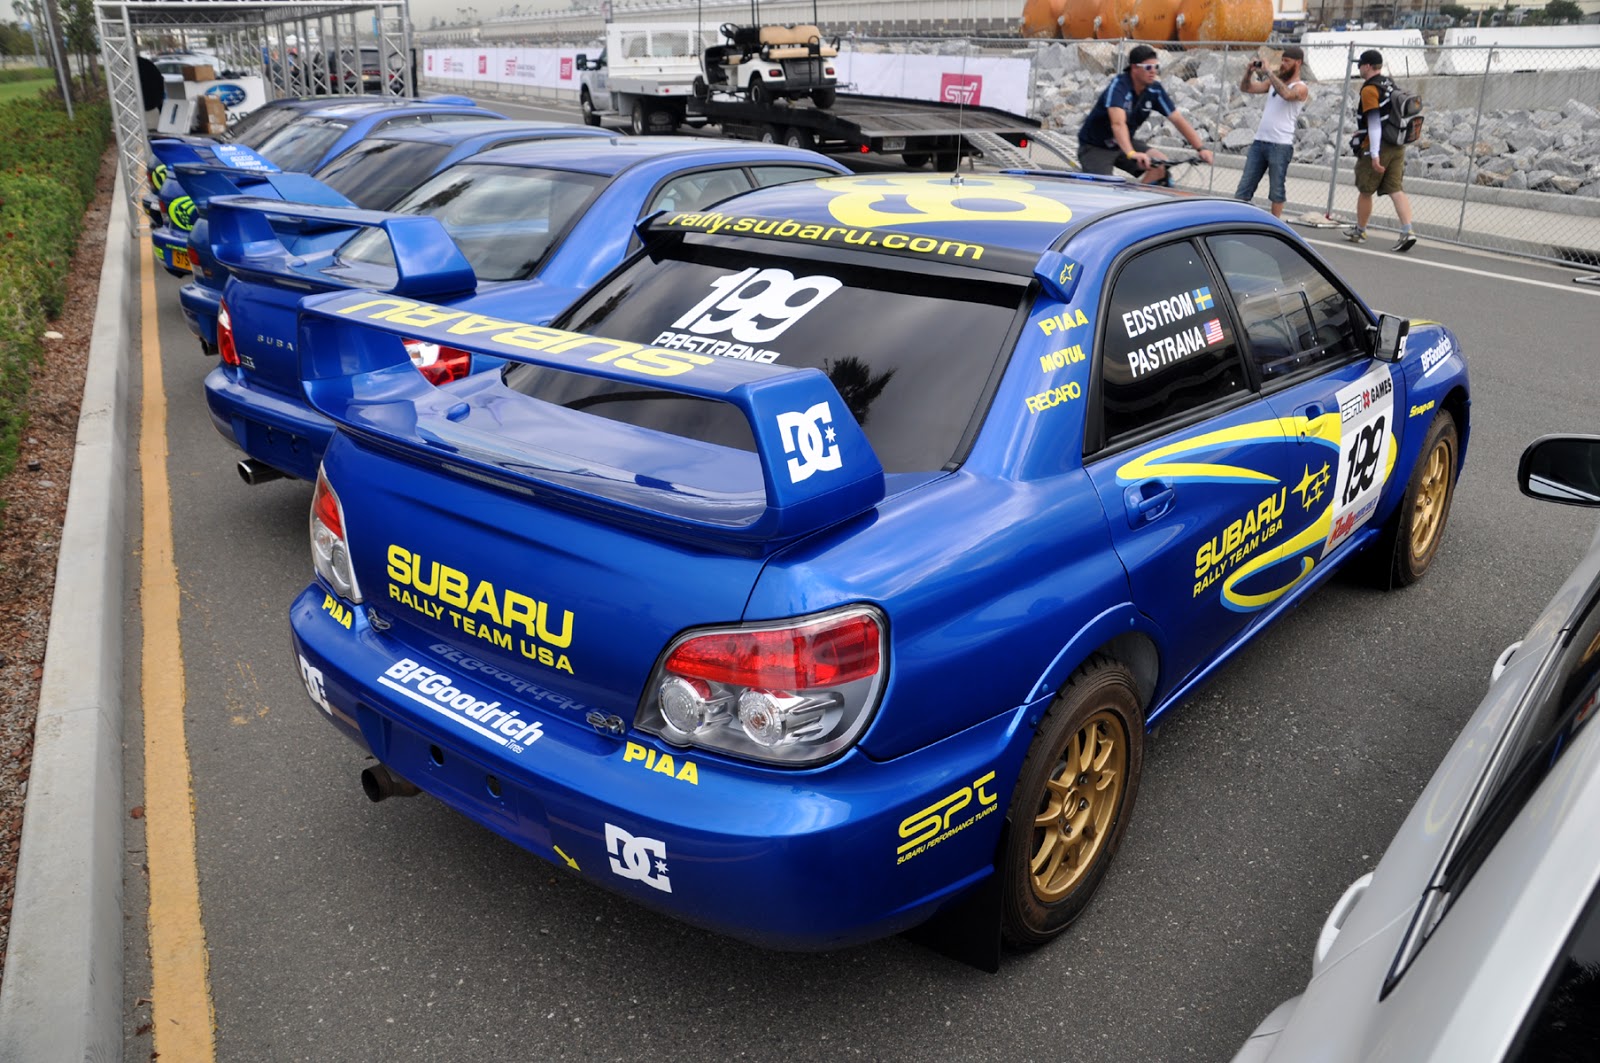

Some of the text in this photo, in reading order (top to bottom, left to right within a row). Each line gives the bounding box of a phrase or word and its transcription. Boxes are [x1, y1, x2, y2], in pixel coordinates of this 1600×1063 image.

[668, 211, 985, 260] rally.subaru.com
[670, 266, 844, 343] 199
[1038, 309, 1089, 336] PIAA
[1122, 292, 1196, 339] EDSTROM
[257, 334, 294, 351] SUBA
[336, 299, 715, 377] SUBARU
[650, 331, 781, 364] PASTRANA
[1039, 344, 1086, 373] MOTUL
[1127, 326, 1206, 378] PASTRANA
[1421, 335, 1452, 372] BFGoodrich
[1025, 381, 1081, 414] RECARO
[1341, 394, 1362, 424] ESPN
[1370, 377, 1392, 404] GAMES
[776, 401, 843, 484] DC
[1342, 415, 1386, 507] 199
[1195, 486, 1287, 578] SUBARU
[1193, 519, 1283, 598] RALLY TEAM USA
[321, 594, 353, 630] PIAA
[387, 544, 575, 648] SUBARU
[388, 583, 575, 675] RALLY TEAM USA
[385, 658, 544, 747] BFGoodrich
[504, 738, 525, 754] Tires
[623, 741, 699, 785] PIAA
[604, 822, 673, 893] DC
[897, 802, 998, 865] SUBARU PERFORMANCE TUNING
